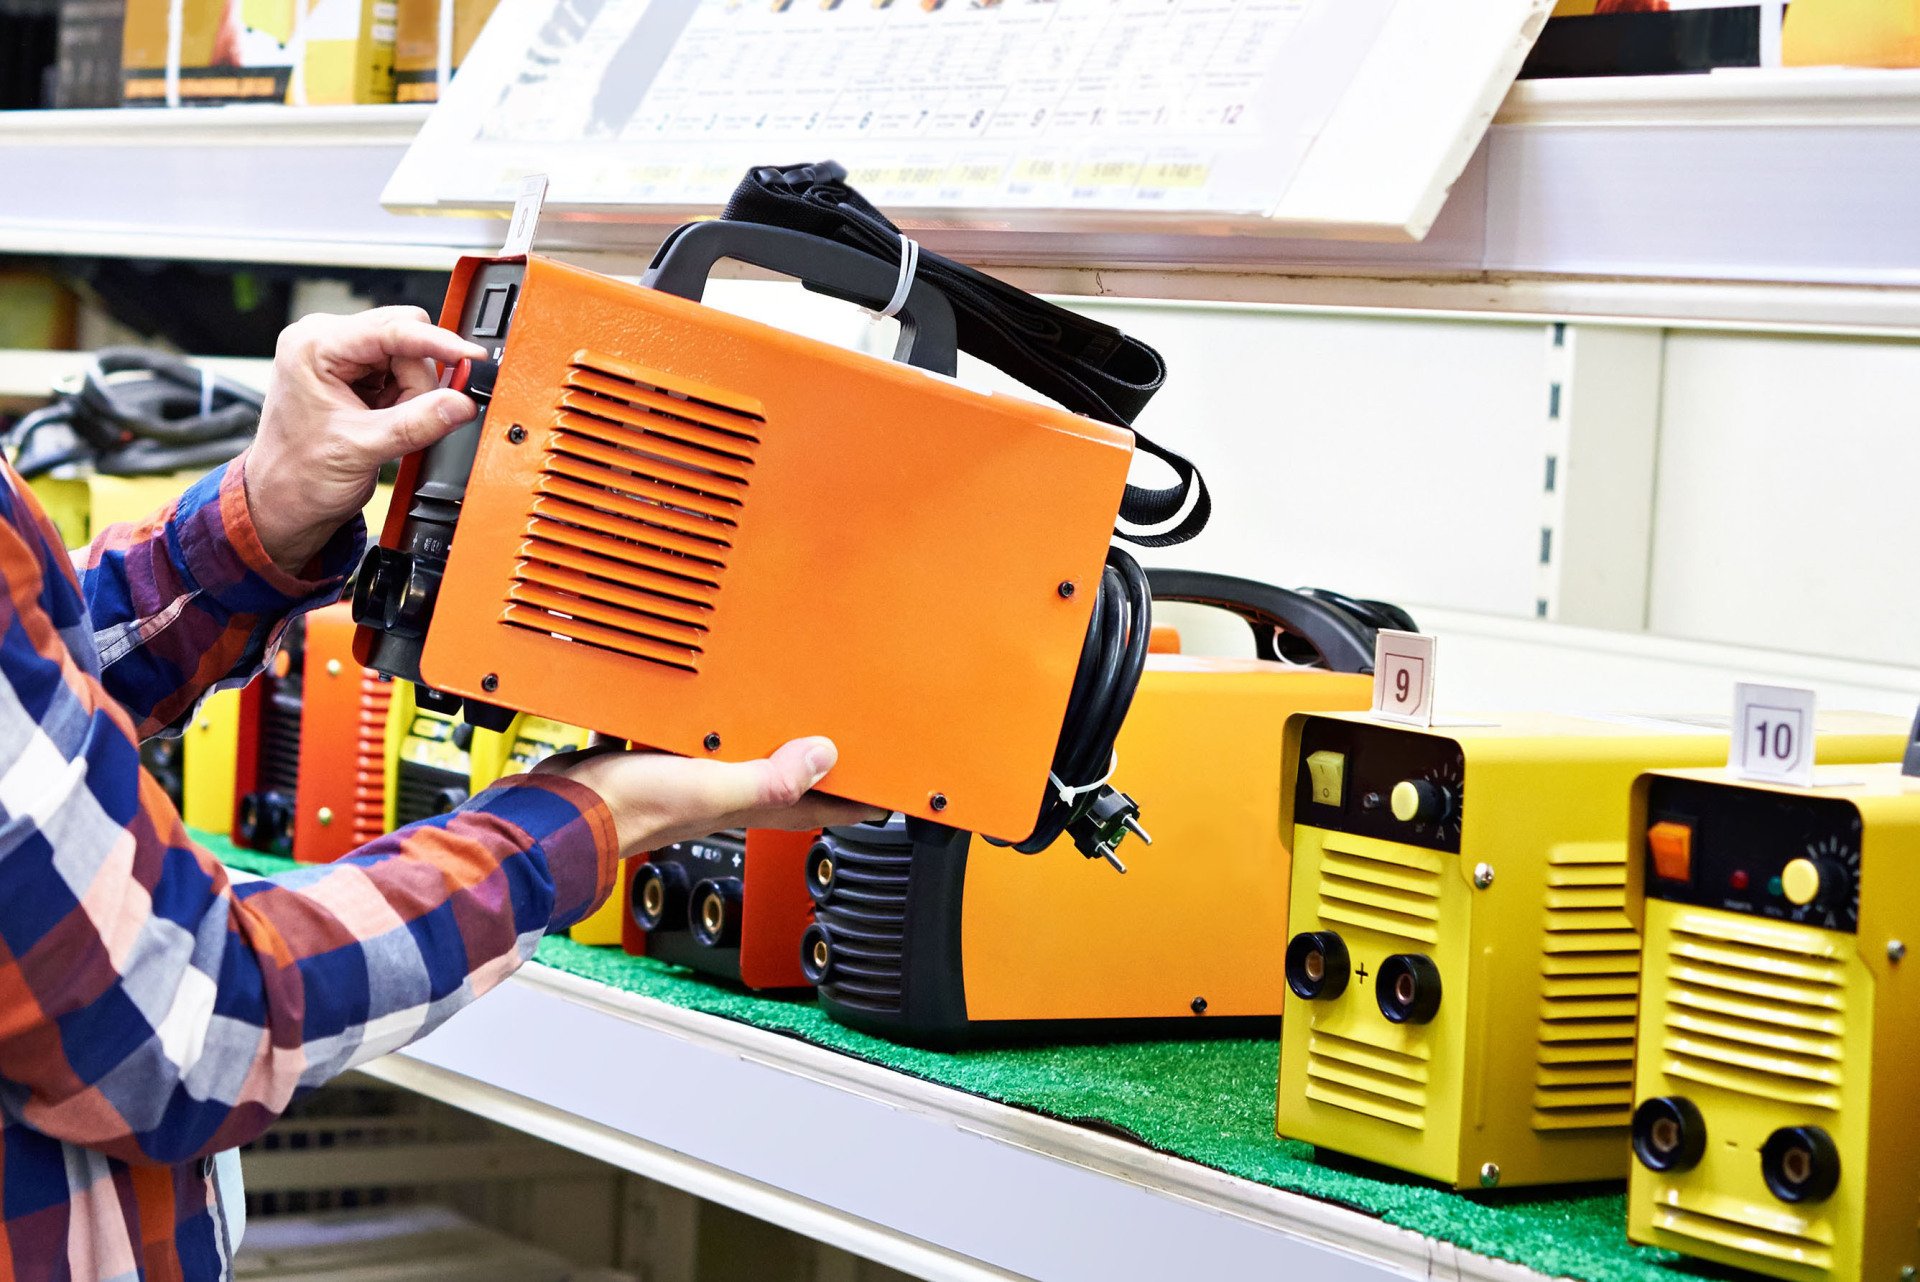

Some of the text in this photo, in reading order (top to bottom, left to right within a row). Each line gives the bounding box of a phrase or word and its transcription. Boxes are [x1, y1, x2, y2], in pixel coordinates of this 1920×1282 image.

[858, 110, 874, 130] 6
[913, 109, 929, 129] 7
[969, 109, 985, 128] 8
[1220, 104, 1245, 125] 12
[516, 206, 529, 239] 8
[1395, 668, 1410, 703] 9
[1755, 721, 1793, 760] 10
[1435, 825, 1446, 841] A
